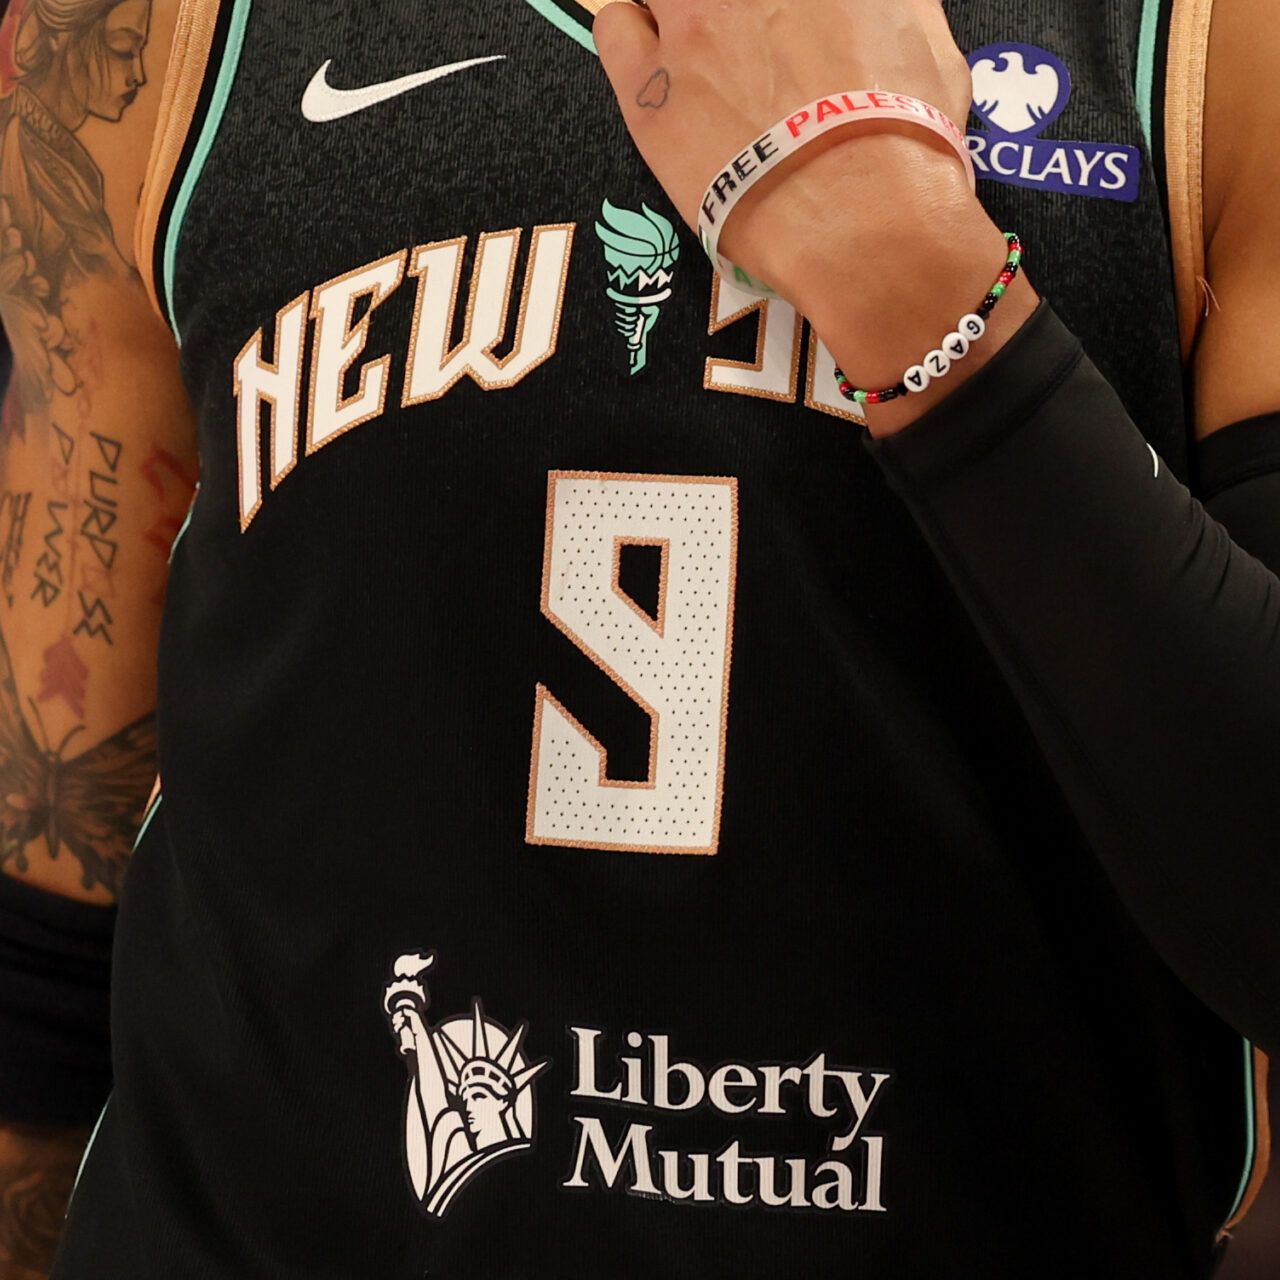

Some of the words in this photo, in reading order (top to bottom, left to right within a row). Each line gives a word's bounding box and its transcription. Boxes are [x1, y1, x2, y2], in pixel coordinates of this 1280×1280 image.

[701, 133, 779, 225] FREE
[965, 136, 1129, 190] RCLAYS
[233, 222, 576, 534] NEW
[907, 320, 981, 387] GAZA
[525, 469, 738, 855] 9
[569, 1025, 891, 1151] Liberty
[562, 1116, 887, 1213] Mutual
